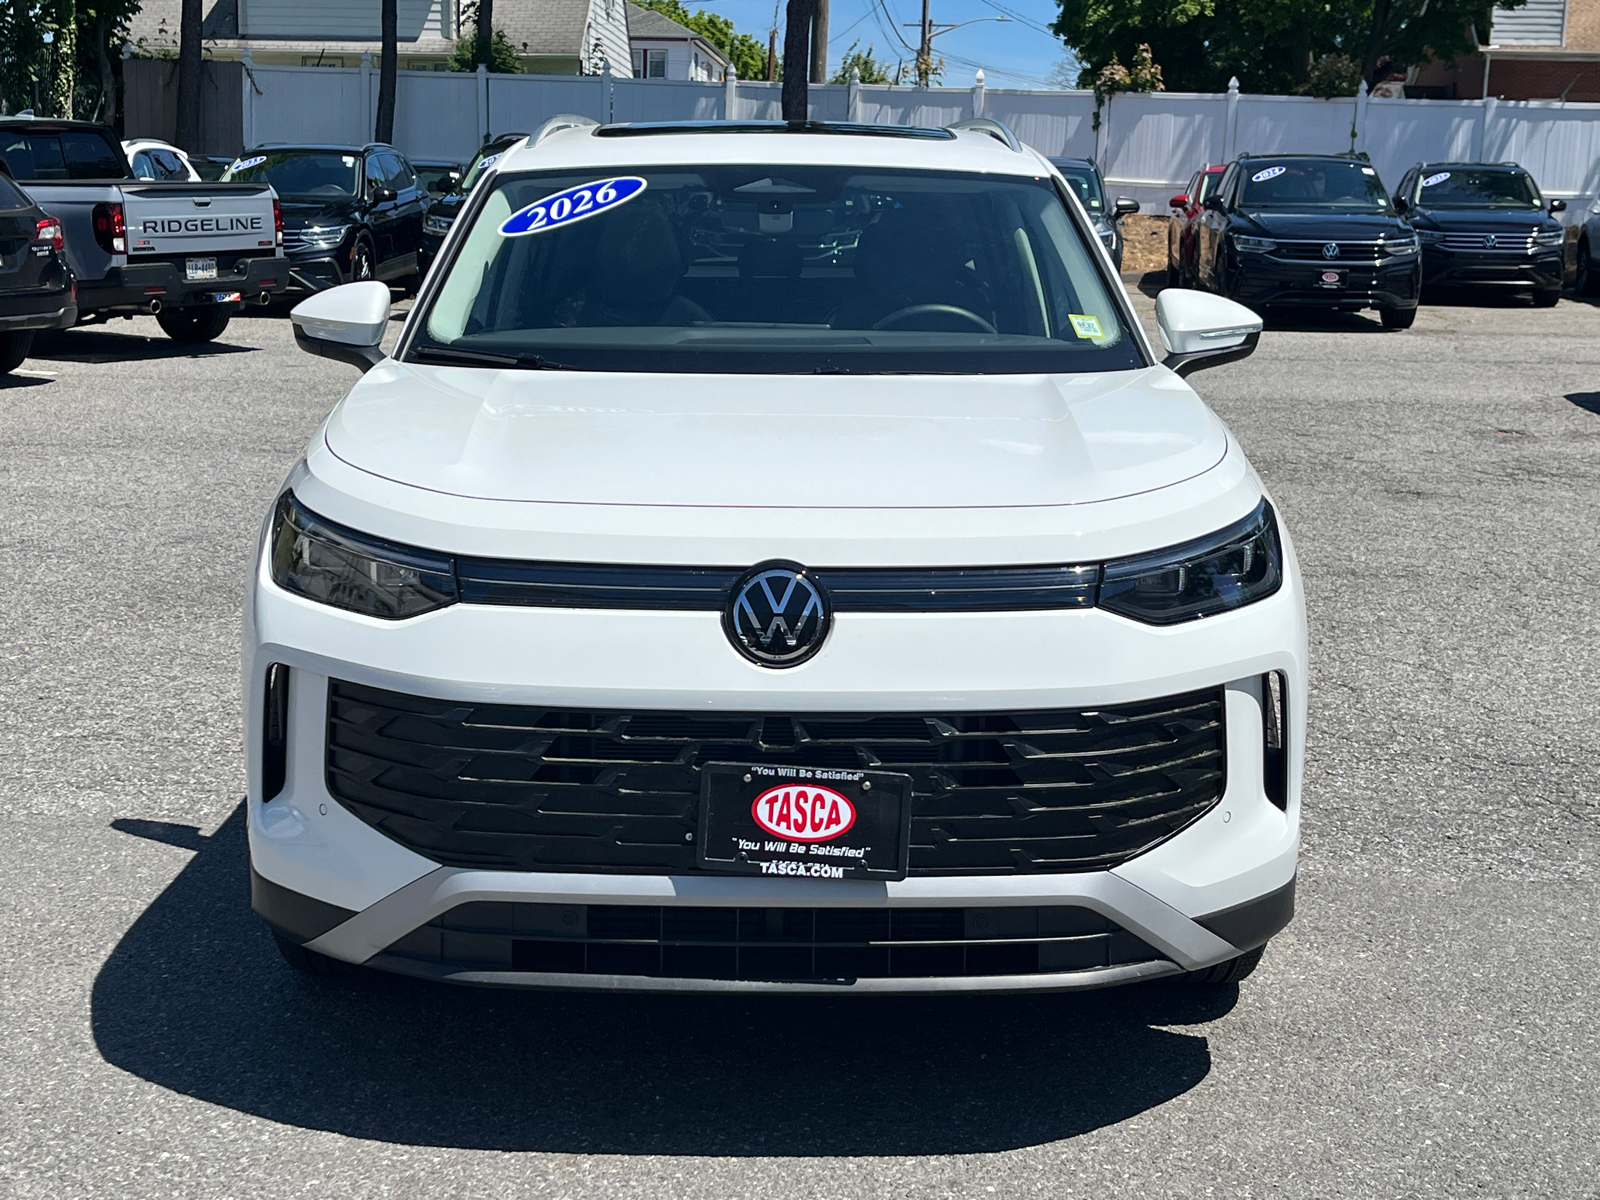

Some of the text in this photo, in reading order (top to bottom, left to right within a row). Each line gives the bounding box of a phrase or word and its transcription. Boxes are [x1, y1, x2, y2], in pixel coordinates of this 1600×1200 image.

[526, 180, 617, 231] 2026
[142, 217, 263, 233] RIDGELINE
[777, 767, 796, 777] Will
[798, 769, 812, 778] Be
[765, 790, 841, 833] TASCA
[764, 840, 786, 853] Will
[788, 843, 806, 854] Be
[760, 862, 843, 878] TASCA.COM
